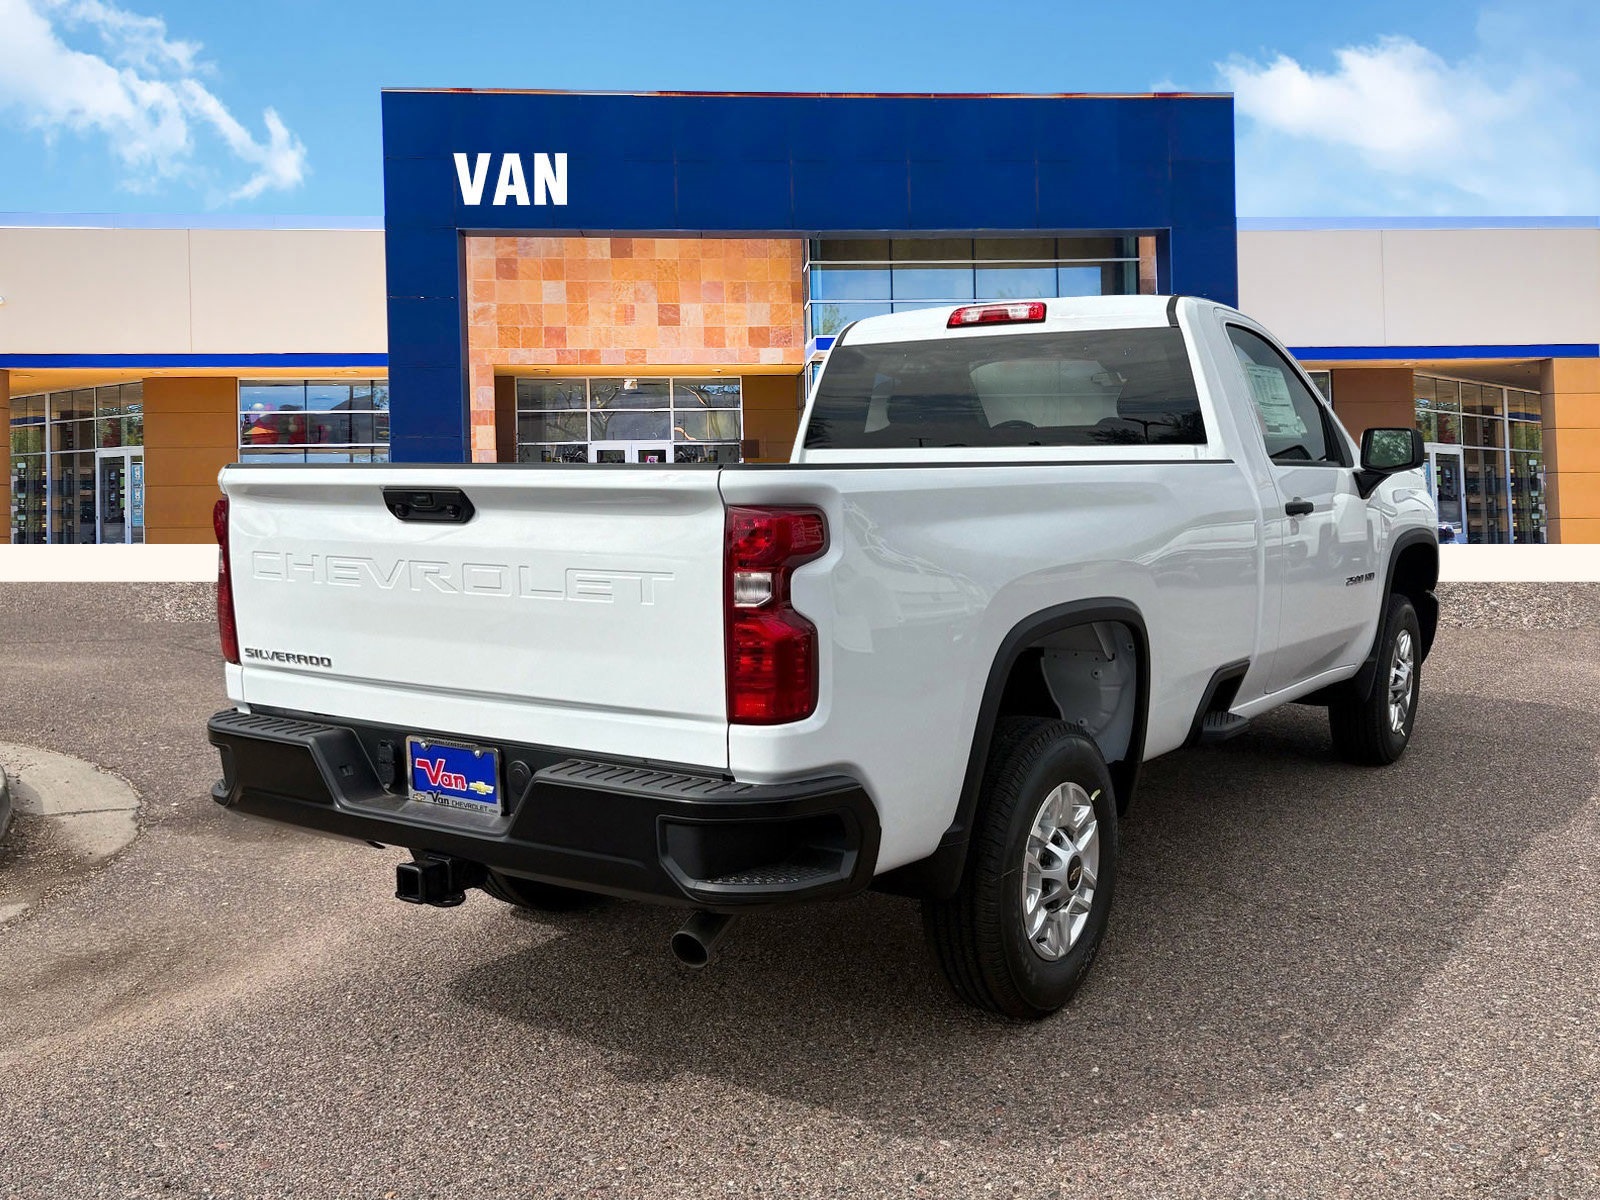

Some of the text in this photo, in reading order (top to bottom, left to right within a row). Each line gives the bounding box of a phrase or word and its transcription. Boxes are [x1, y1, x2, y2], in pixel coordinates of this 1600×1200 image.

[452, 152, 568, 206] VAN
[251, 550, 676, 606] CHEVROLET
[244, 647, 332, 668] SILVERADO
[415, 758, 467, 791] Van
[426, 790, 450, 805] Van
[451, 800, 488, 812] CHEVROLET
